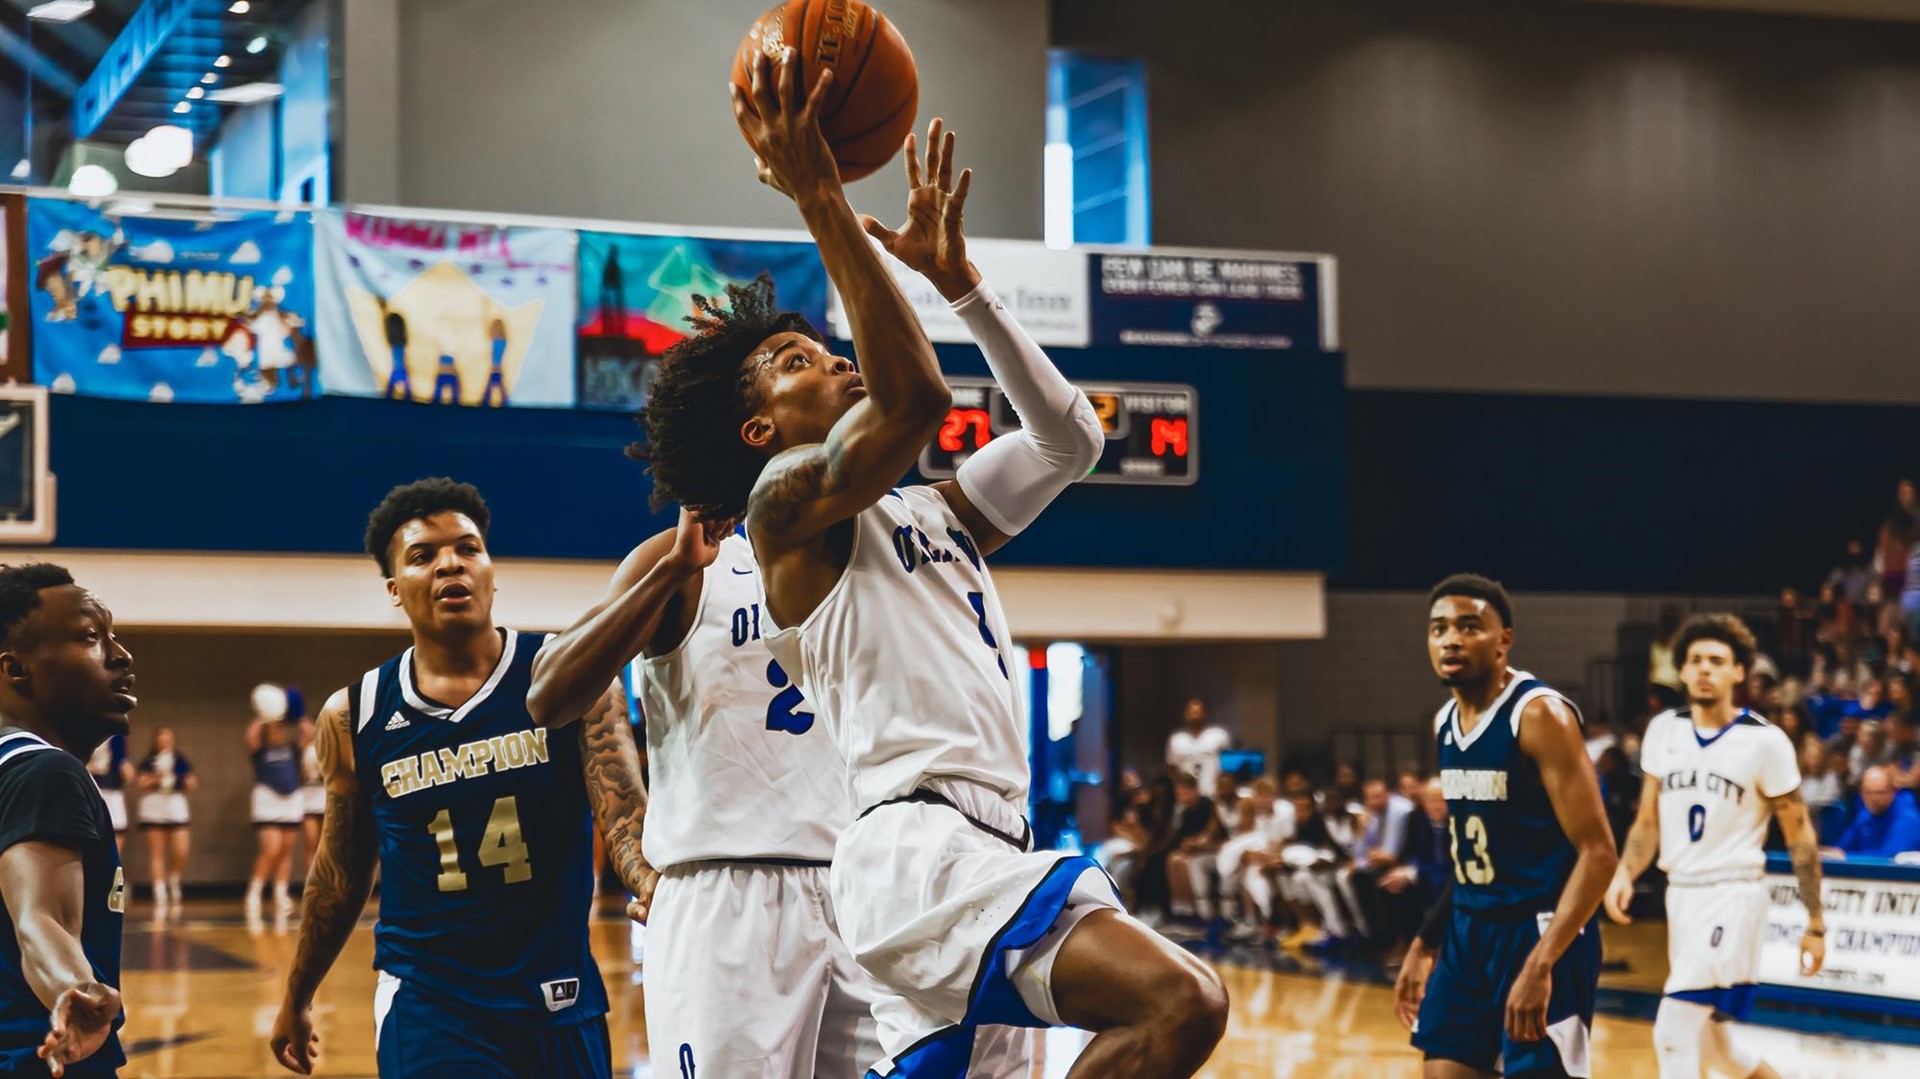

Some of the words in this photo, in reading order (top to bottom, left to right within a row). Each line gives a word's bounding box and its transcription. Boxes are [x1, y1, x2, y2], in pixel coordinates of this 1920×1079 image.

[131, 315, 228, 341] STORY
[381, 727, 549, 798] CHAMPION
[427, 795, 532, 891] 14
[1449, 815, 1495, 885] 13
